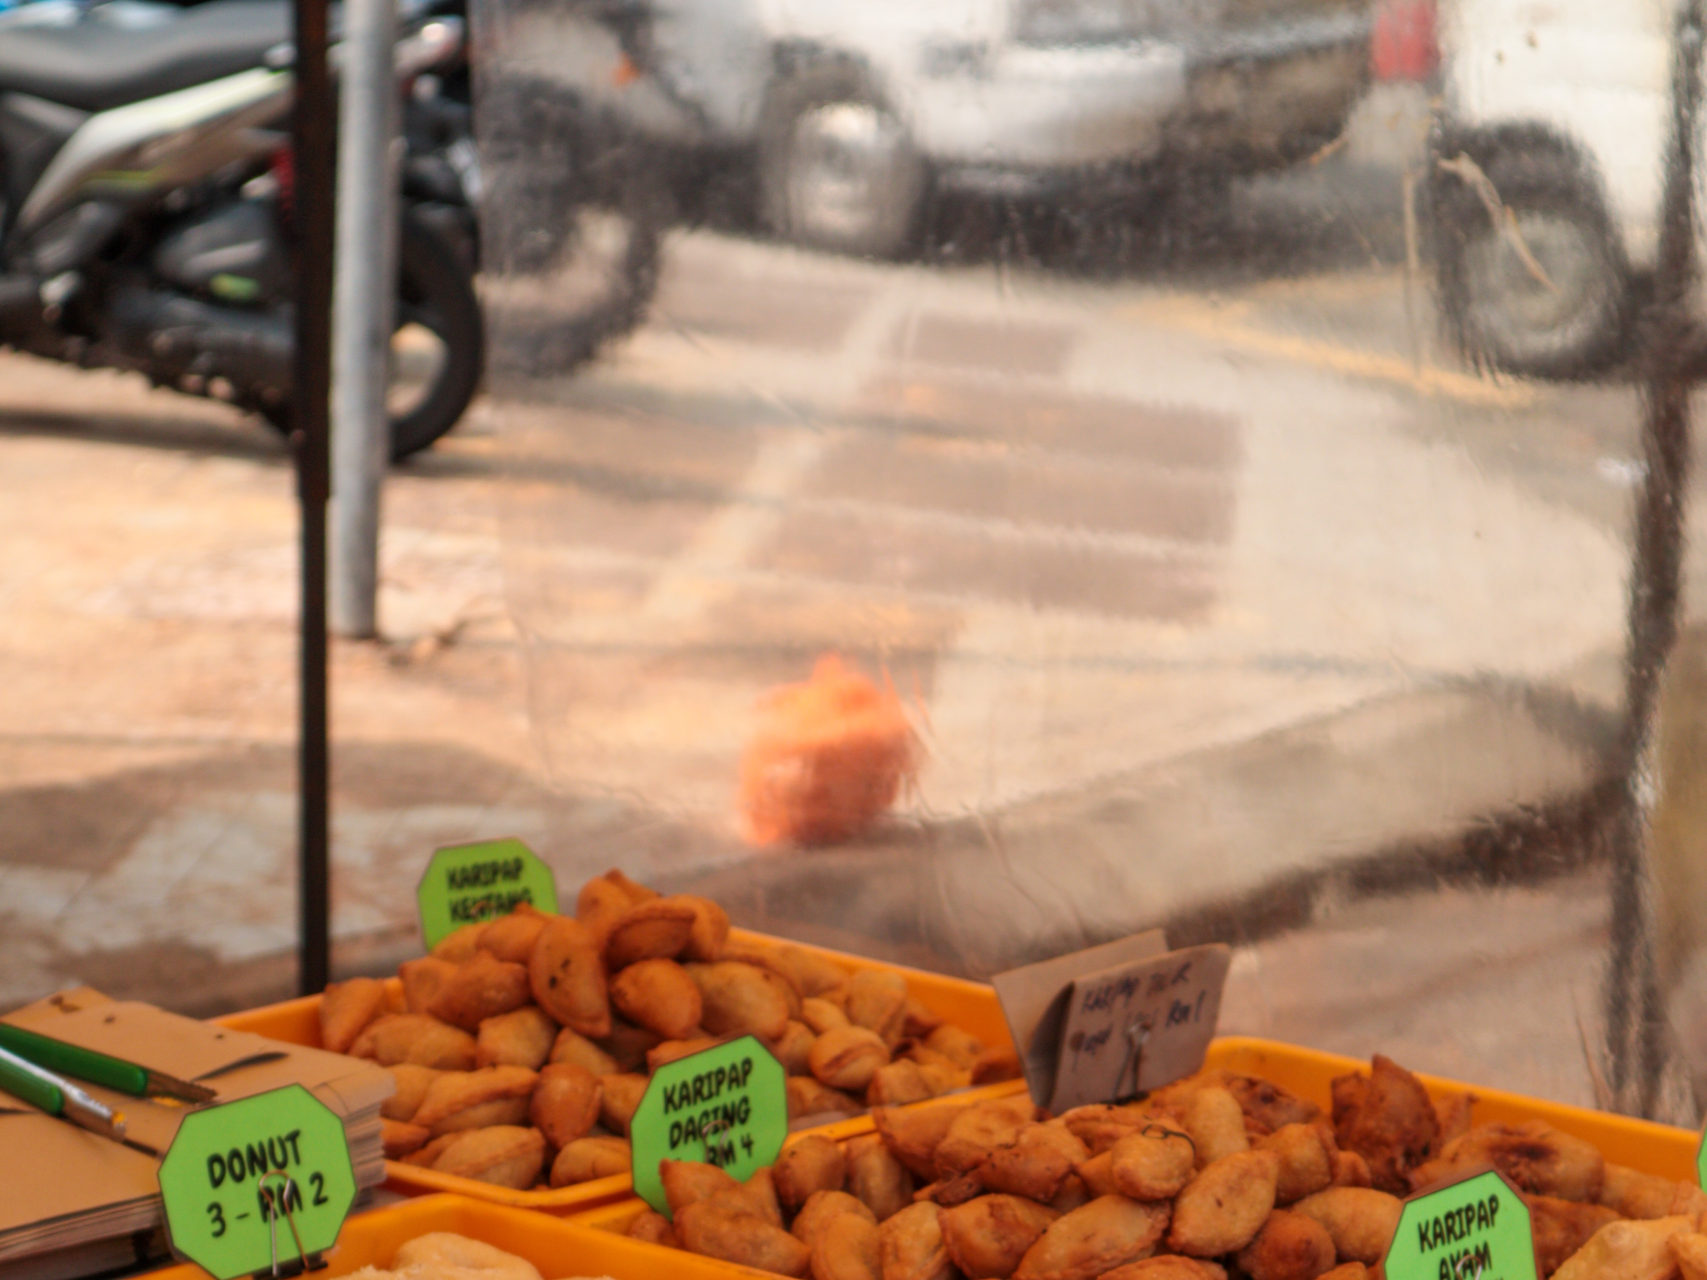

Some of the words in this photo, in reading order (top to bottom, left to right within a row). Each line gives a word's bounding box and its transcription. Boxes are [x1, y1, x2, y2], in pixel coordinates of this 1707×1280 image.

[663, 1057, 753, 1115] KARIPAP
[669, 1096, 752, 1150] DAGING
[741, 1132, 754, 1158] 4
[207, 1129, 301, 1189] DONUT
[207, 1202, 226, 1238] 3
[258, 1178, 303, 1223] RM
[309, 1172, 328, 1206] 2
[1418, 1194, 1499, 1253] KARIPAP
